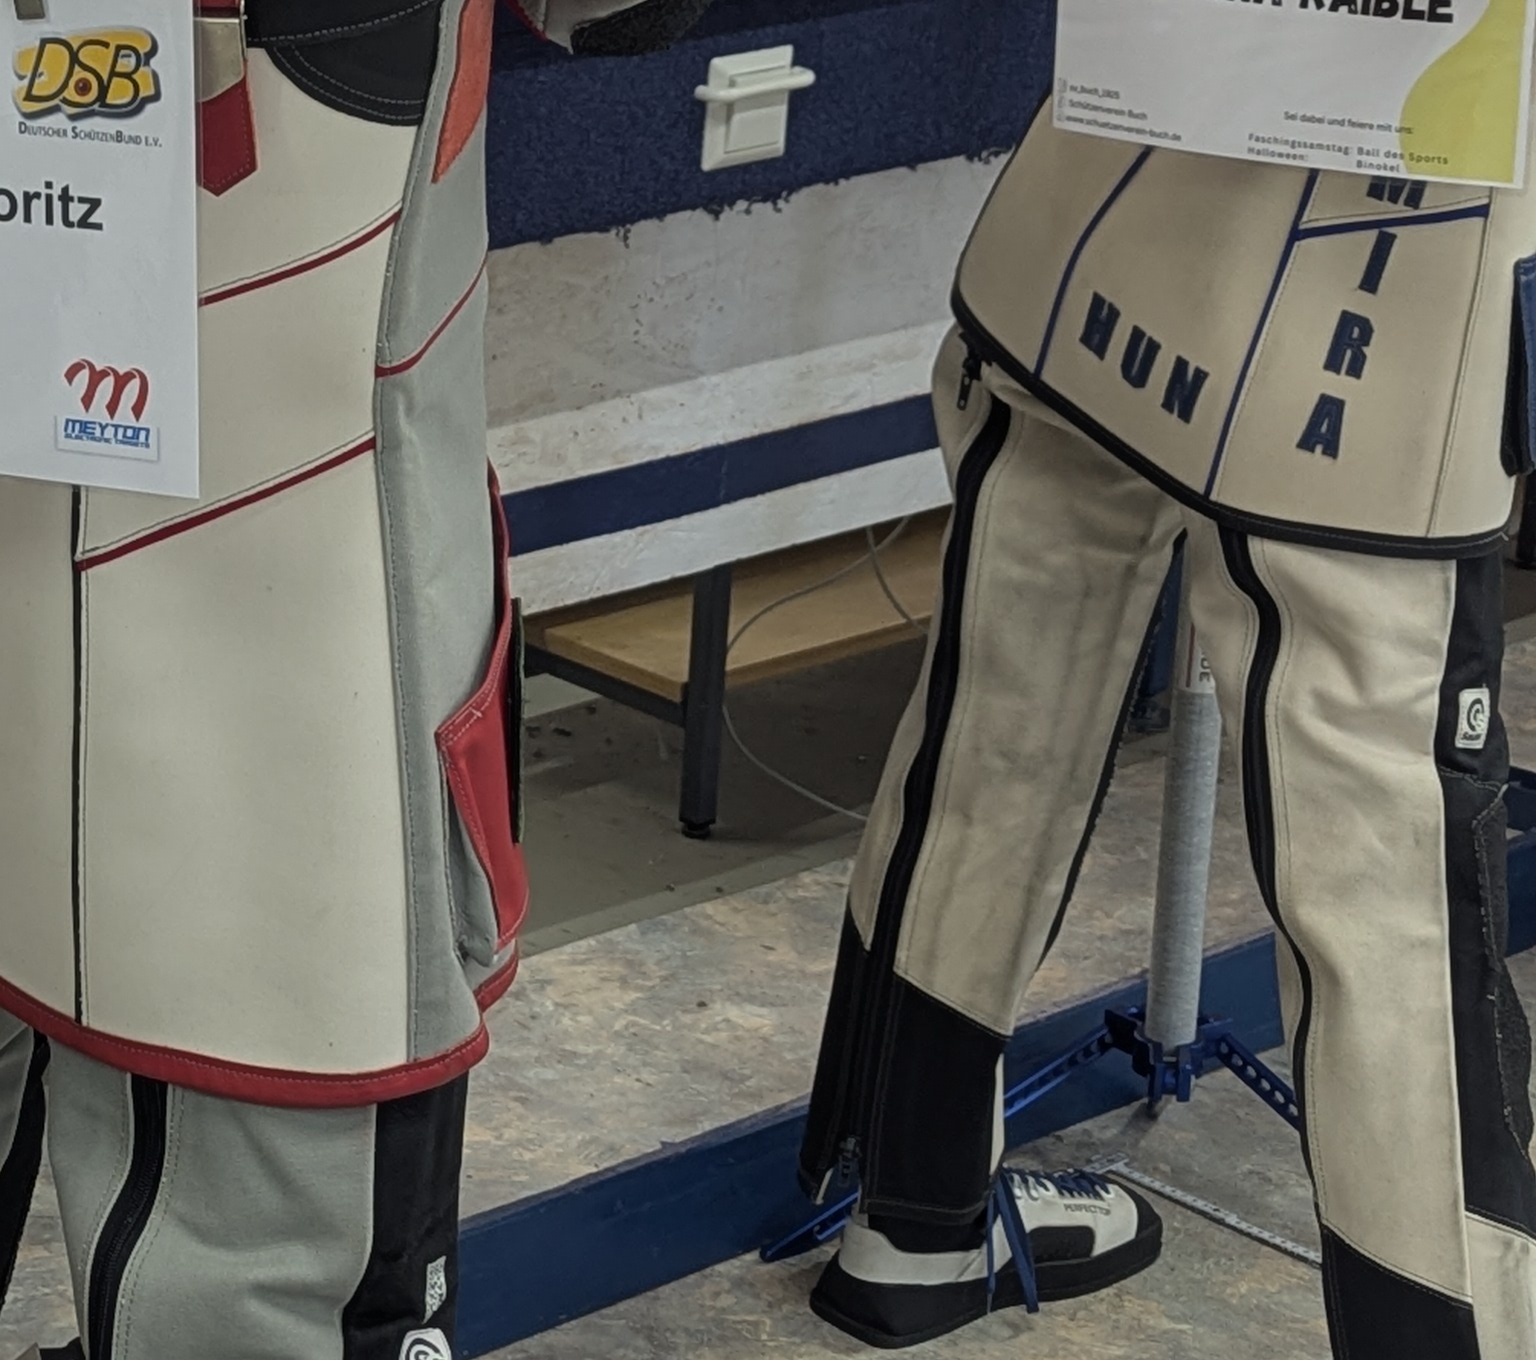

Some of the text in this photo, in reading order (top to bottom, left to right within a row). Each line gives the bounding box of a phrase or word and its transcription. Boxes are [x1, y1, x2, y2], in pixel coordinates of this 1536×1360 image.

[23, 37, 141, 109] DSB
[1327, 117, 1346, 128] und
[1357, 147, 1380, 158] Ball
[1384, 150, 1404, 161] des
[1408, 152, 1449, 165] Sports
[1079, 291, 1210, 423] HUN
[64, 418, 150, 443] MEYTON
